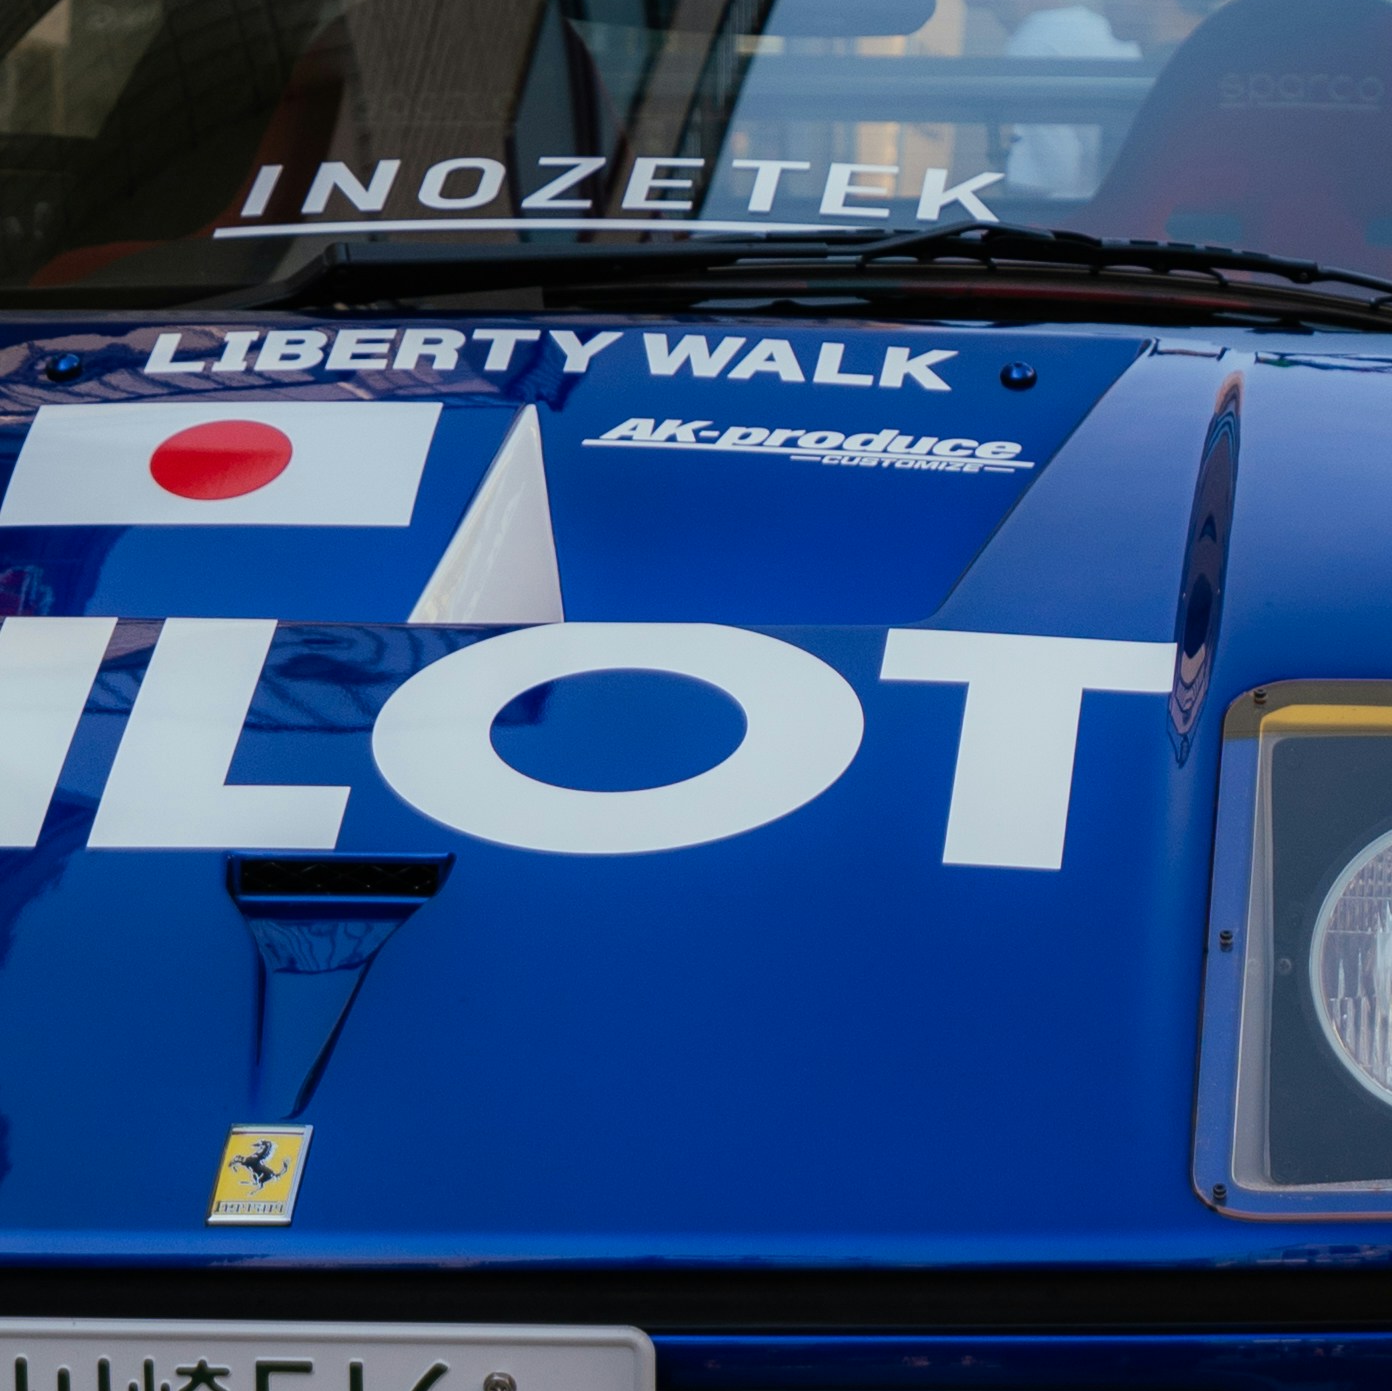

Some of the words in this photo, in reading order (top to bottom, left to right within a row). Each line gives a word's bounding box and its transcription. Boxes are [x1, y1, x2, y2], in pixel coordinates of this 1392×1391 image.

[1218, 72, 1385, 106] sparco
[240, 157, 1006, 222] INOZETEK
[143, 328, 623, 375] LIBERTY
[643, 333, 958, 392] WALK
[600, 417, 1022, 460] AK-produce
[822, 455, 984, 473] CUSTOMIZE
